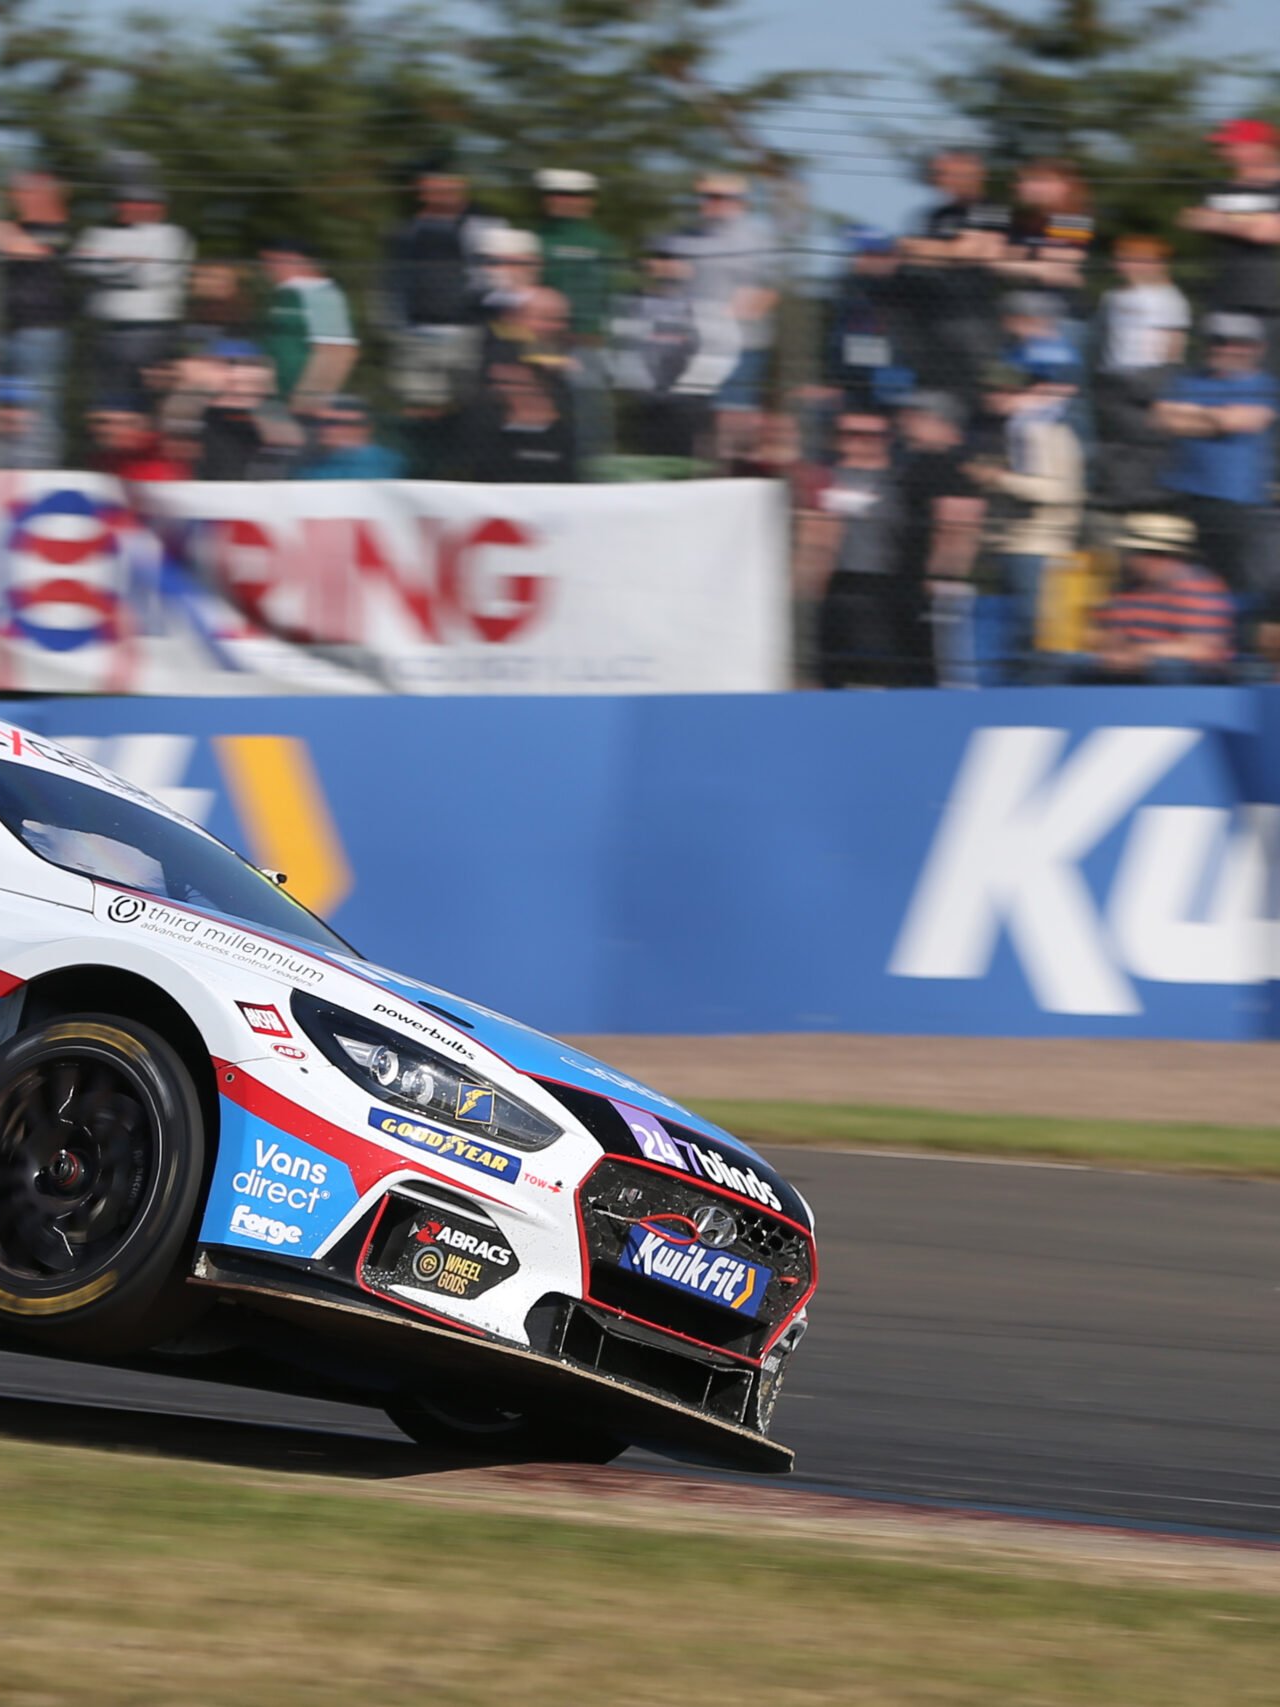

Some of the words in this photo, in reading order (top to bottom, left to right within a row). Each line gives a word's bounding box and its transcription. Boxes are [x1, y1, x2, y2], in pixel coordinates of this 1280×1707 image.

[140, 921, 193, 944] advanced
[194, 939, 230, 956] access
[231, 952, 271, 970] control
[271, 967, 314, 987] readers
[148, 906, 202, 933] third
[202, 925, 325, 983] millennium
[276, 1046, 303, 1058] ABS
[372, 1002, 477, 1062] powerbulbs
[255, 1138, 328, 1184] Vans
[523, 1172, 548, 1189] TOW
[231, 1204, 303, 1246] Forge
[436, 1222, 513, 1267] ABRACS
[437, 1271, 469, 1295] GODS
[445, 1253, 483, 1283] WHEEL
